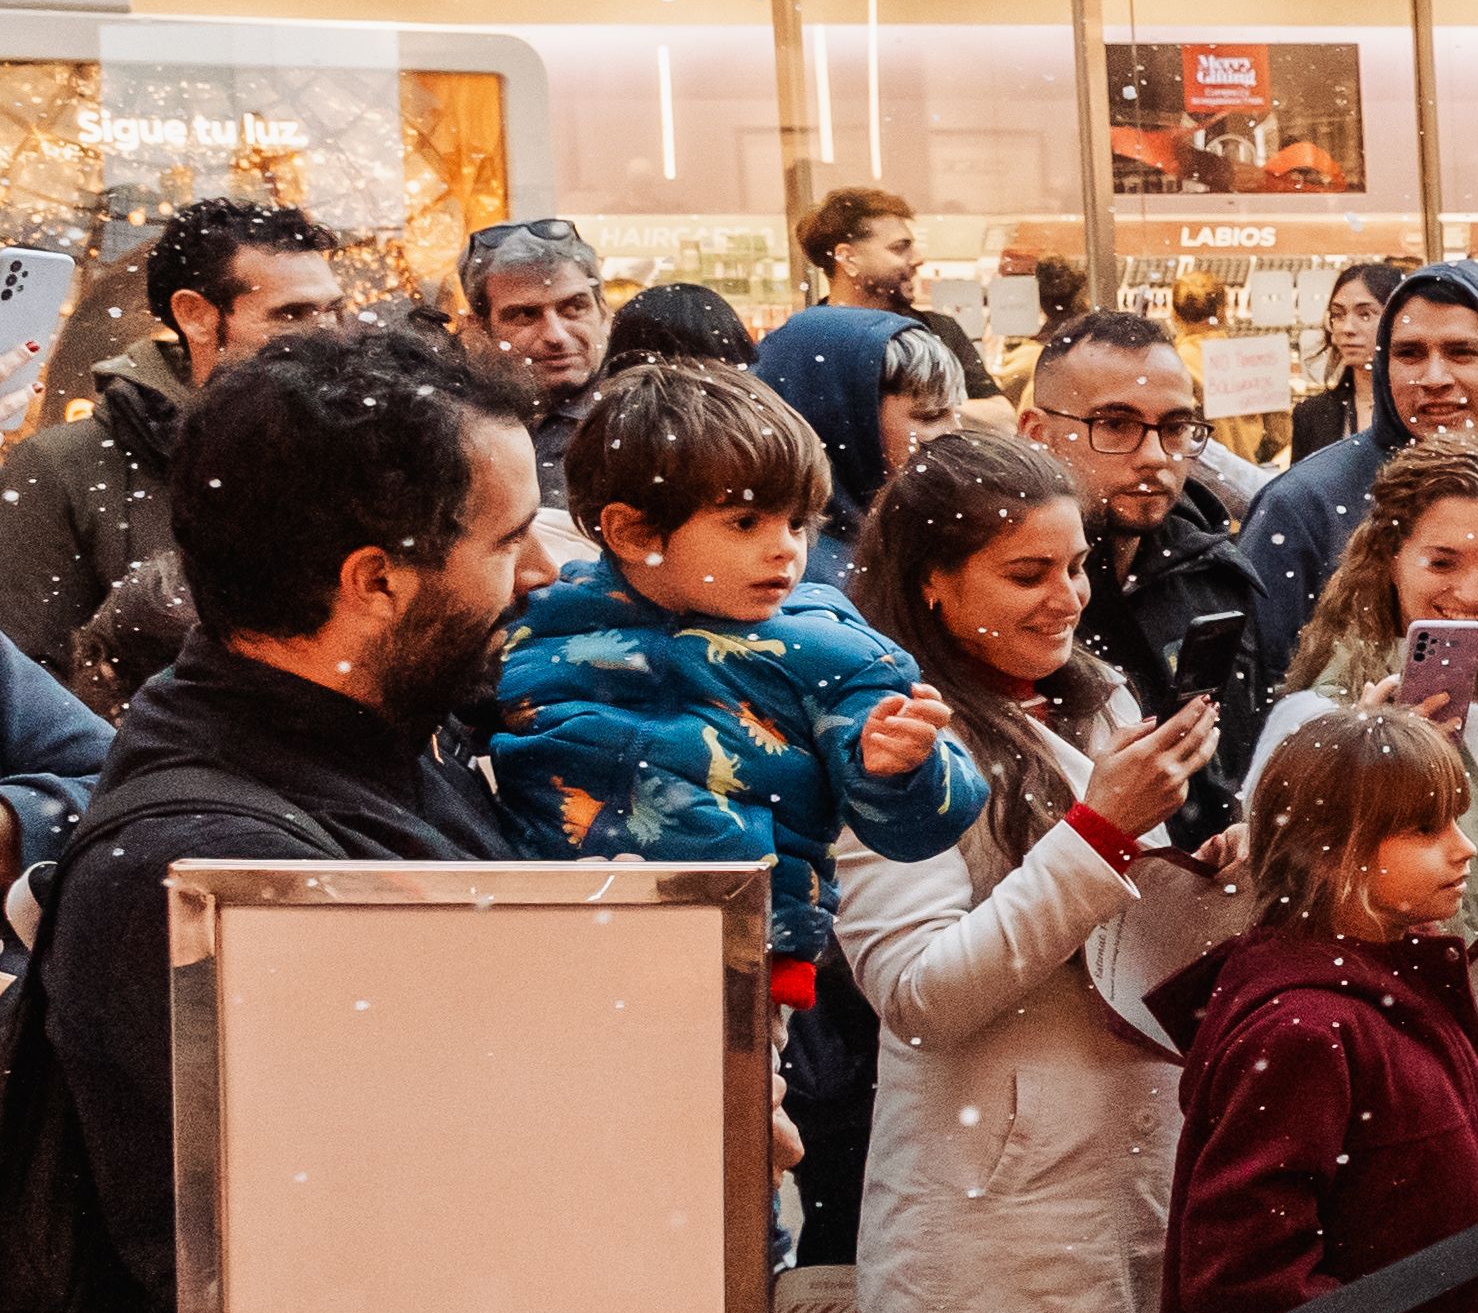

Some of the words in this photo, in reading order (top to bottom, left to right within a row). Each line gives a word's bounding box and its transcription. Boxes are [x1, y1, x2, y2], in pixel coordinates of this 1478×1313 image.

[76, 109, 189, 151] Sigue
[192, 113, 238, 146] tu
[1180, 225, 1277, 248] LABIOS
